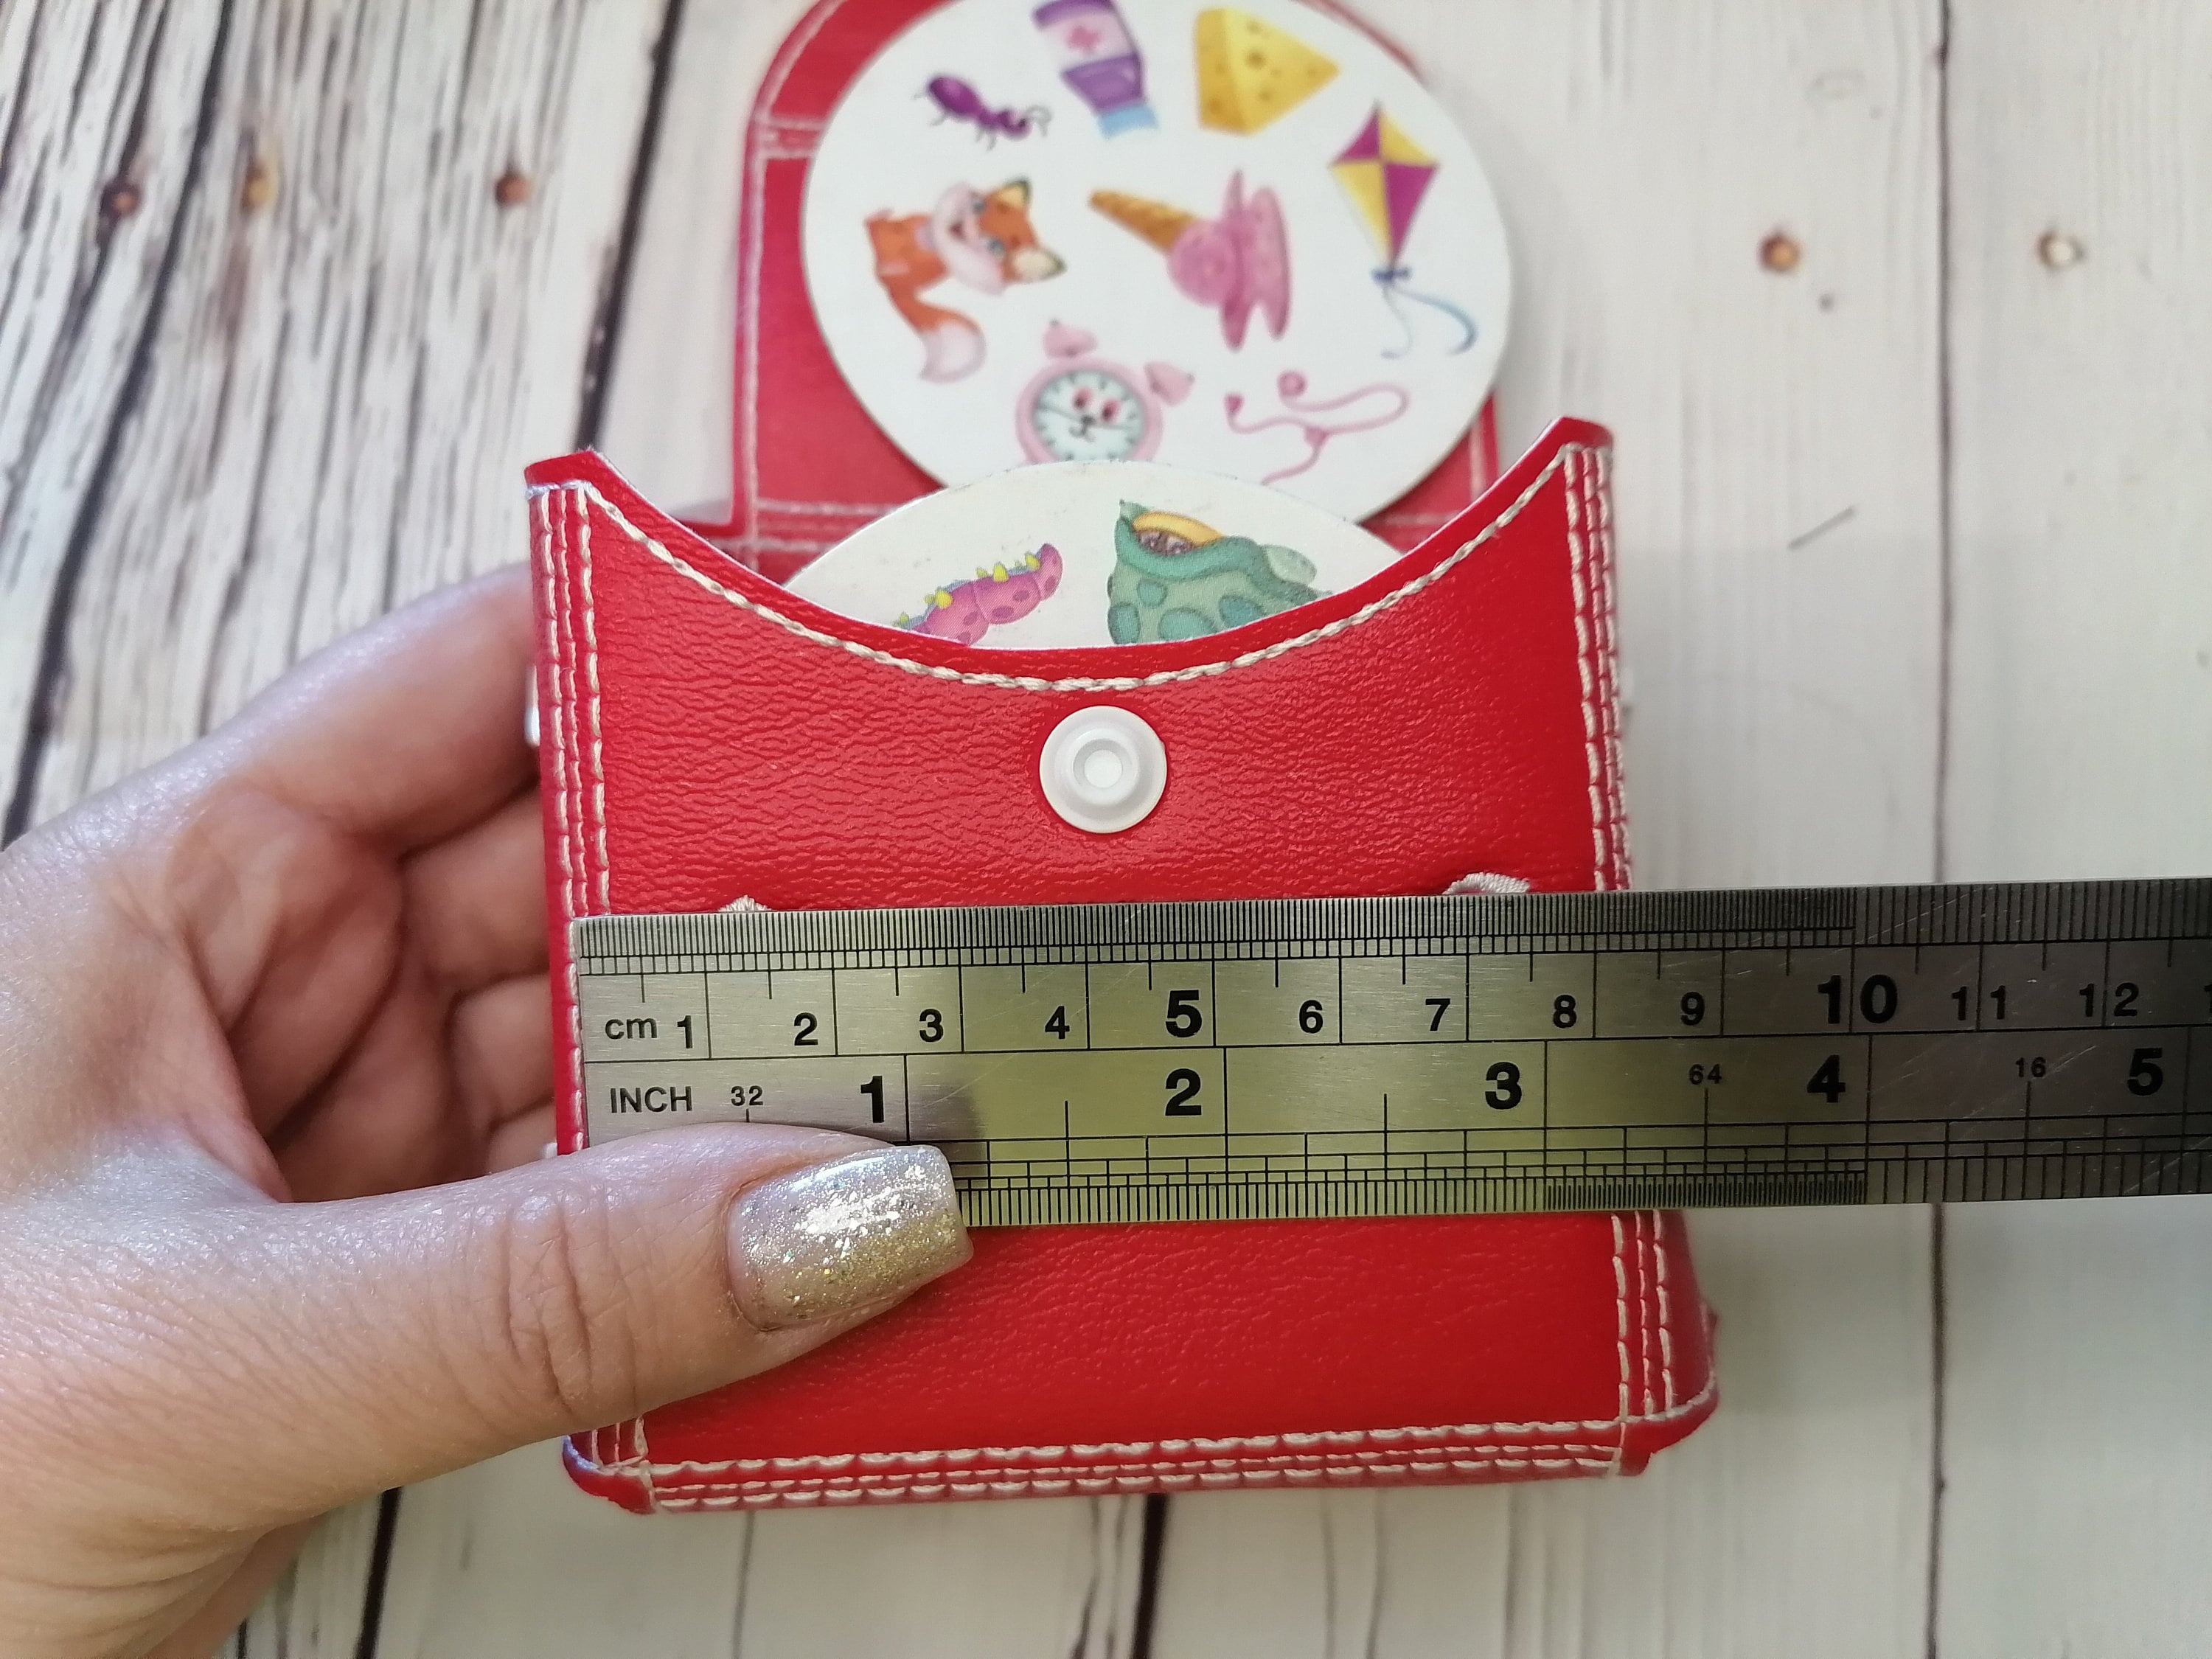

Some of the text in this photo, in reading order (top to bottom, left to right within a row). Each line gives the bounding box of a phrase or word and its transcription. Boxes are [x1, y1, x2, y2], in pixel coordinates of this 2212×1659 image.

[604, 974, 2140, 1048] cm 1 2 3 4 5 6 7 8 9 10 11 12
[610, 1047, 2165, 1123] INCH 32 1 2 3 64 4 16 5
